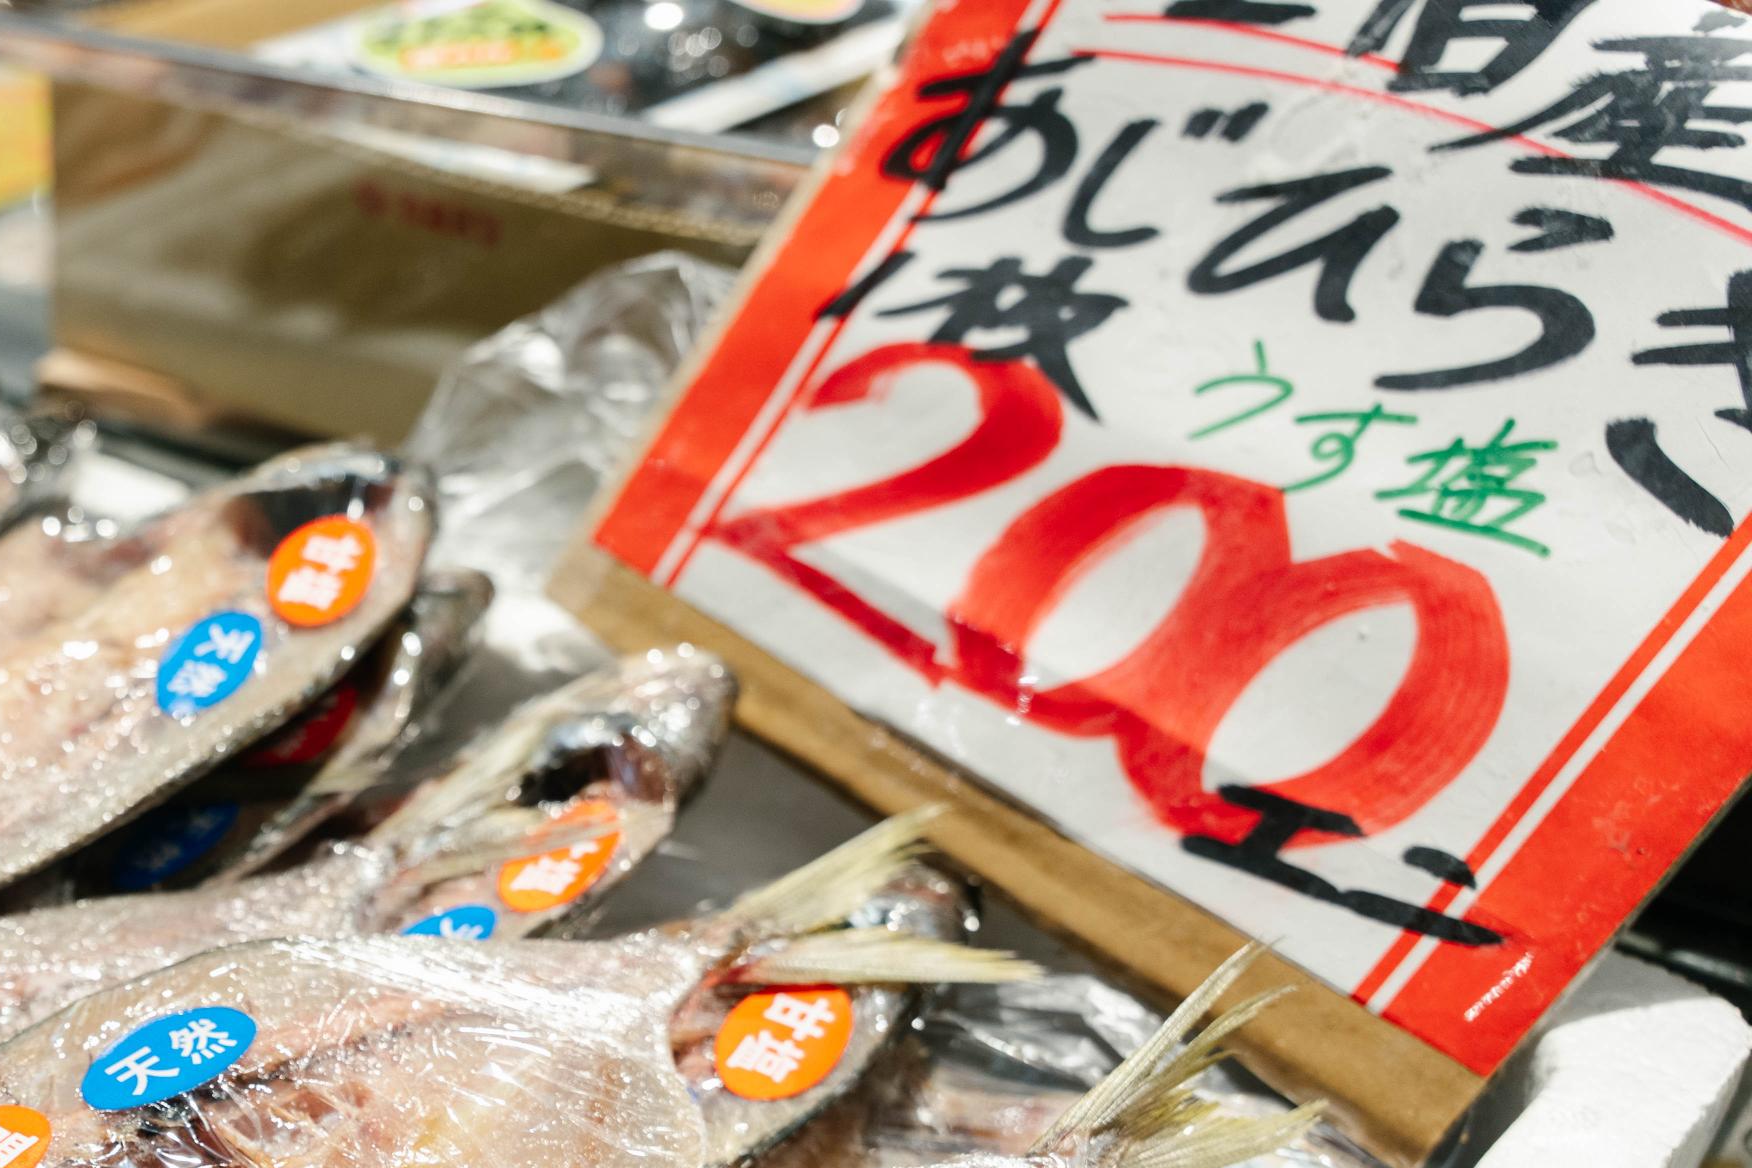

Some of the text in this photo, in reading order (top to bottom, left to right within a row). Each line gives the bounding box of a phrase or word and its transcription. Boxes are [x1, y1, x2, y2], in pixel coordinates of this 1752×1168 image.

[1188, 340, 1560, 557] うす塩
[690, 340, 1512, 850] 200
[104, 1018, 240, 1097] 天然
